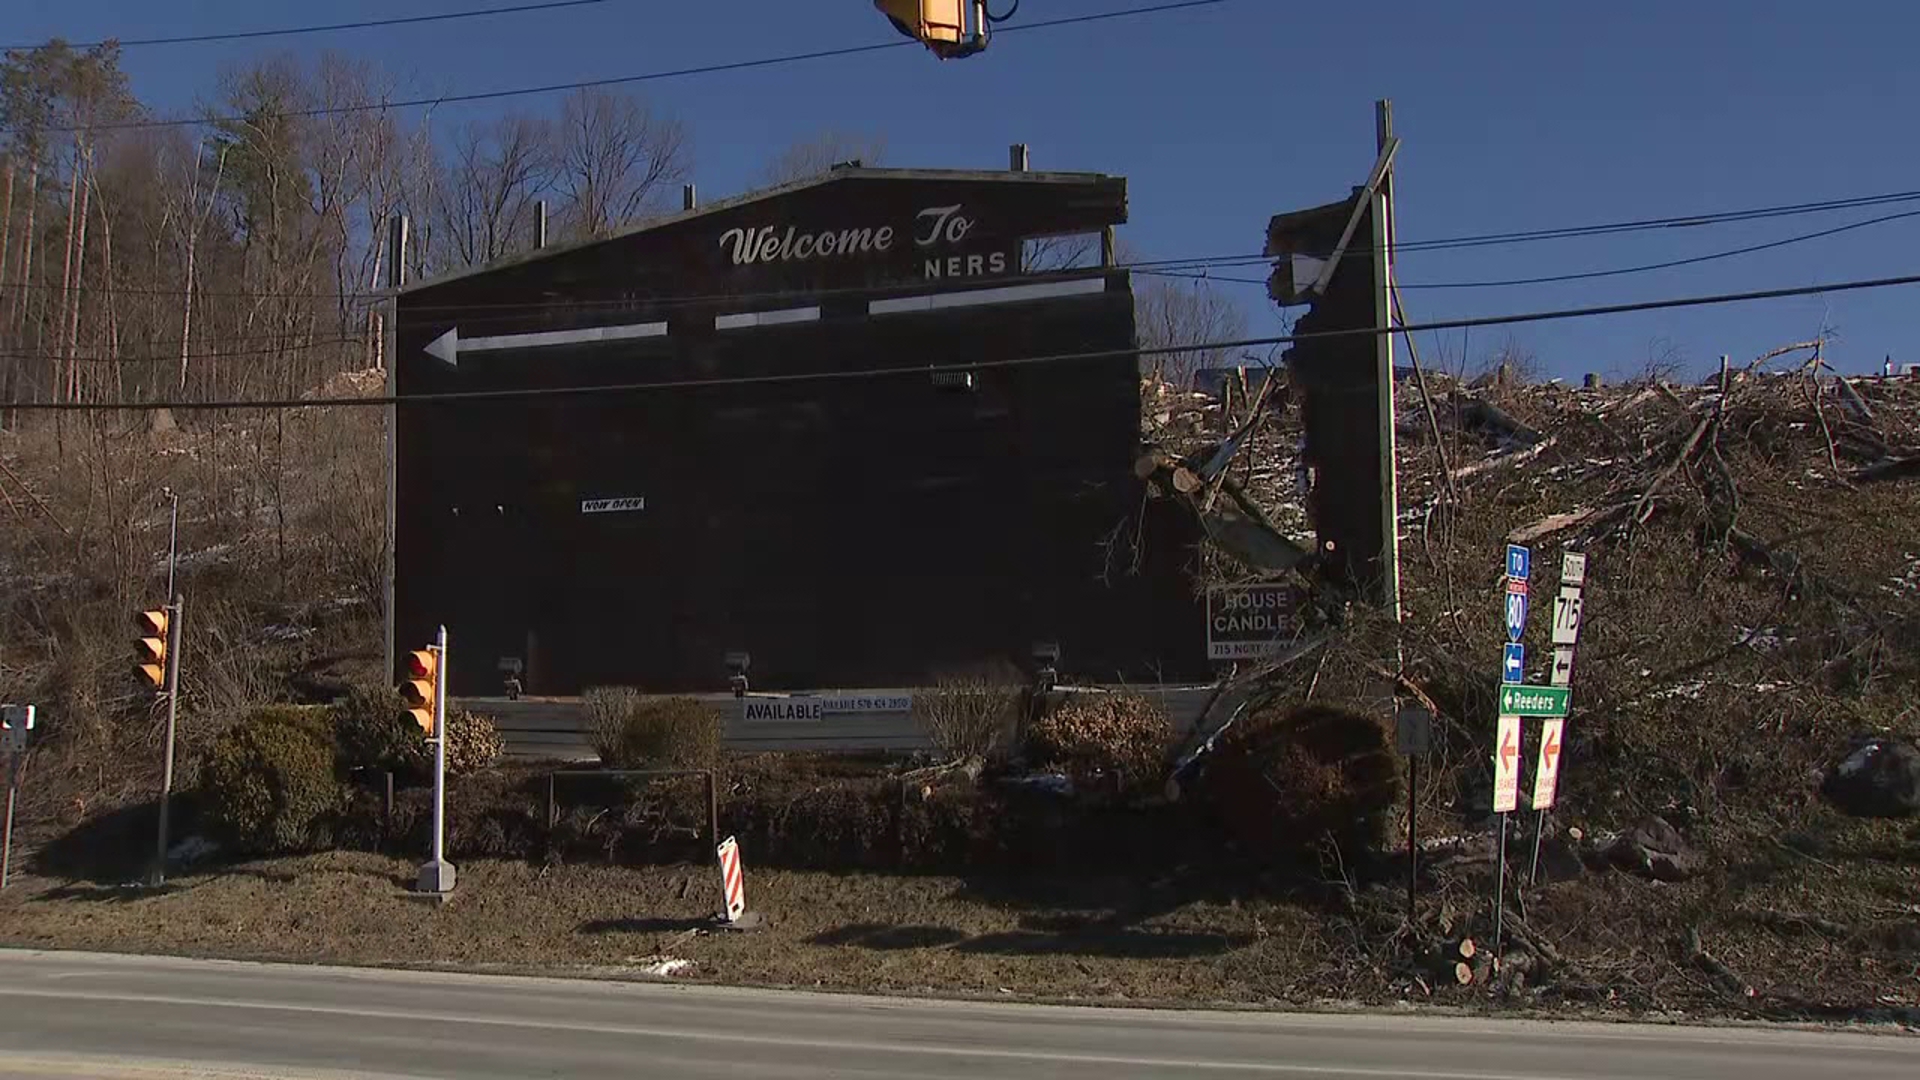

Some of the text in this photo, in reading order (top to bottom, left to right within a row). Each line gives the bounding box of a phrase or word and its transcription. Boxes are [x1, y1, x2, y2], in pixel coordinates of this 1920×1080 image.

[720, 204, 975, 265] Welcome To
[925, 252, 1006, 280] NERS
[584, 498, 642, 511] NOW OPEN
[1511, 553, 1524, 571] TO
[1225, 592, 1287, 609] HOUSE
[1508, 595, 1522, 629] 80
[1556, 598, 1580, 631] 715
[857, 699, 872, 708] 570
[1514, 692, 1554, 710] Reeders
[746, 704, 820, 720] AVAILABLE
